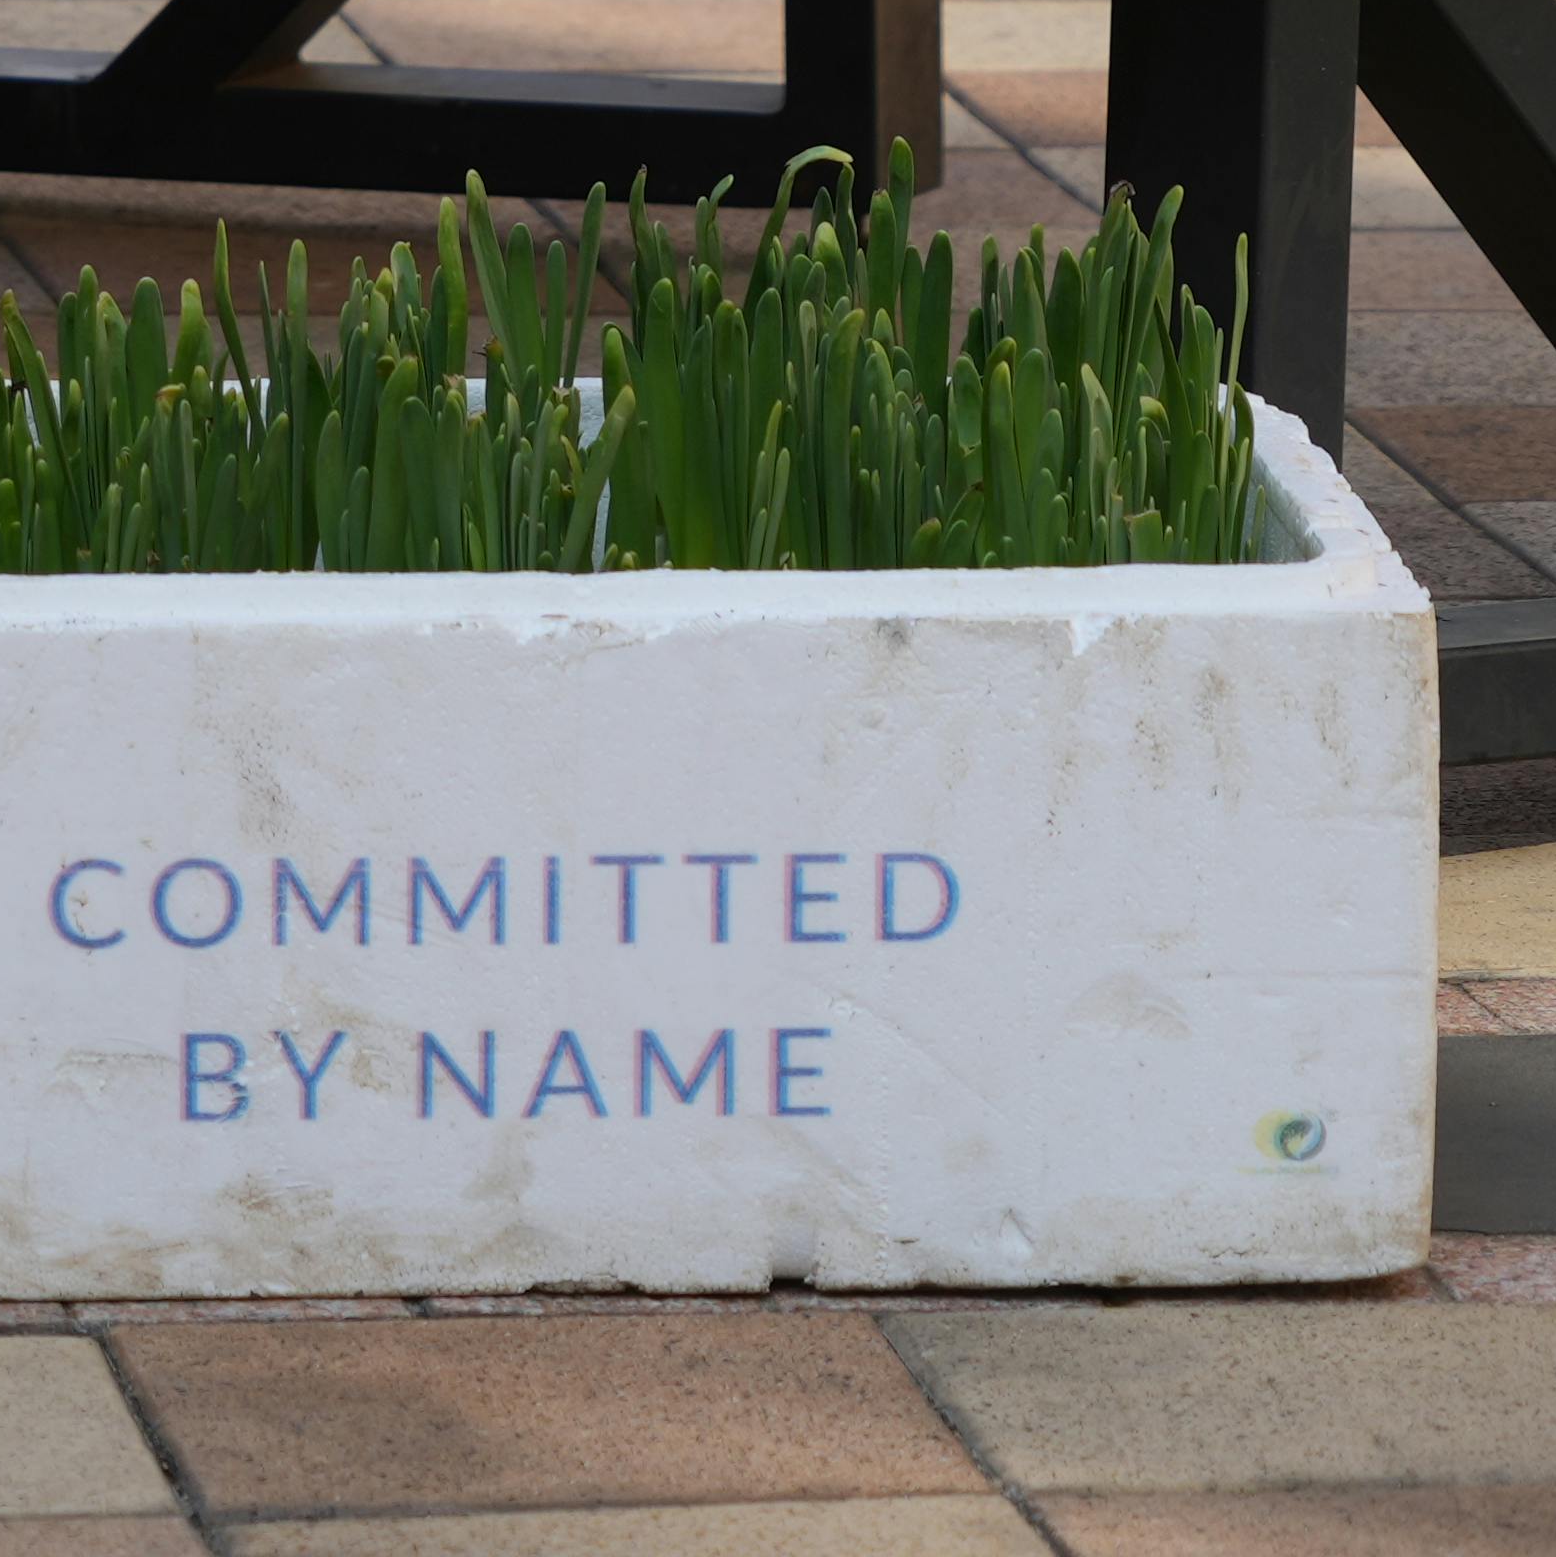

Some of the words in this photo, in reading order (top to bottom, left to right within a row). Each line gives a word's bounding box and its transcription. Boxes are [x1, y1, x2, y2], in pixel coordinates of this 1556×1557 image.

[47, 851, 962, 949] COMMITTED
[179, 1029, 348, 1122] BY
[416, 1026, 833, 1120] NAME
